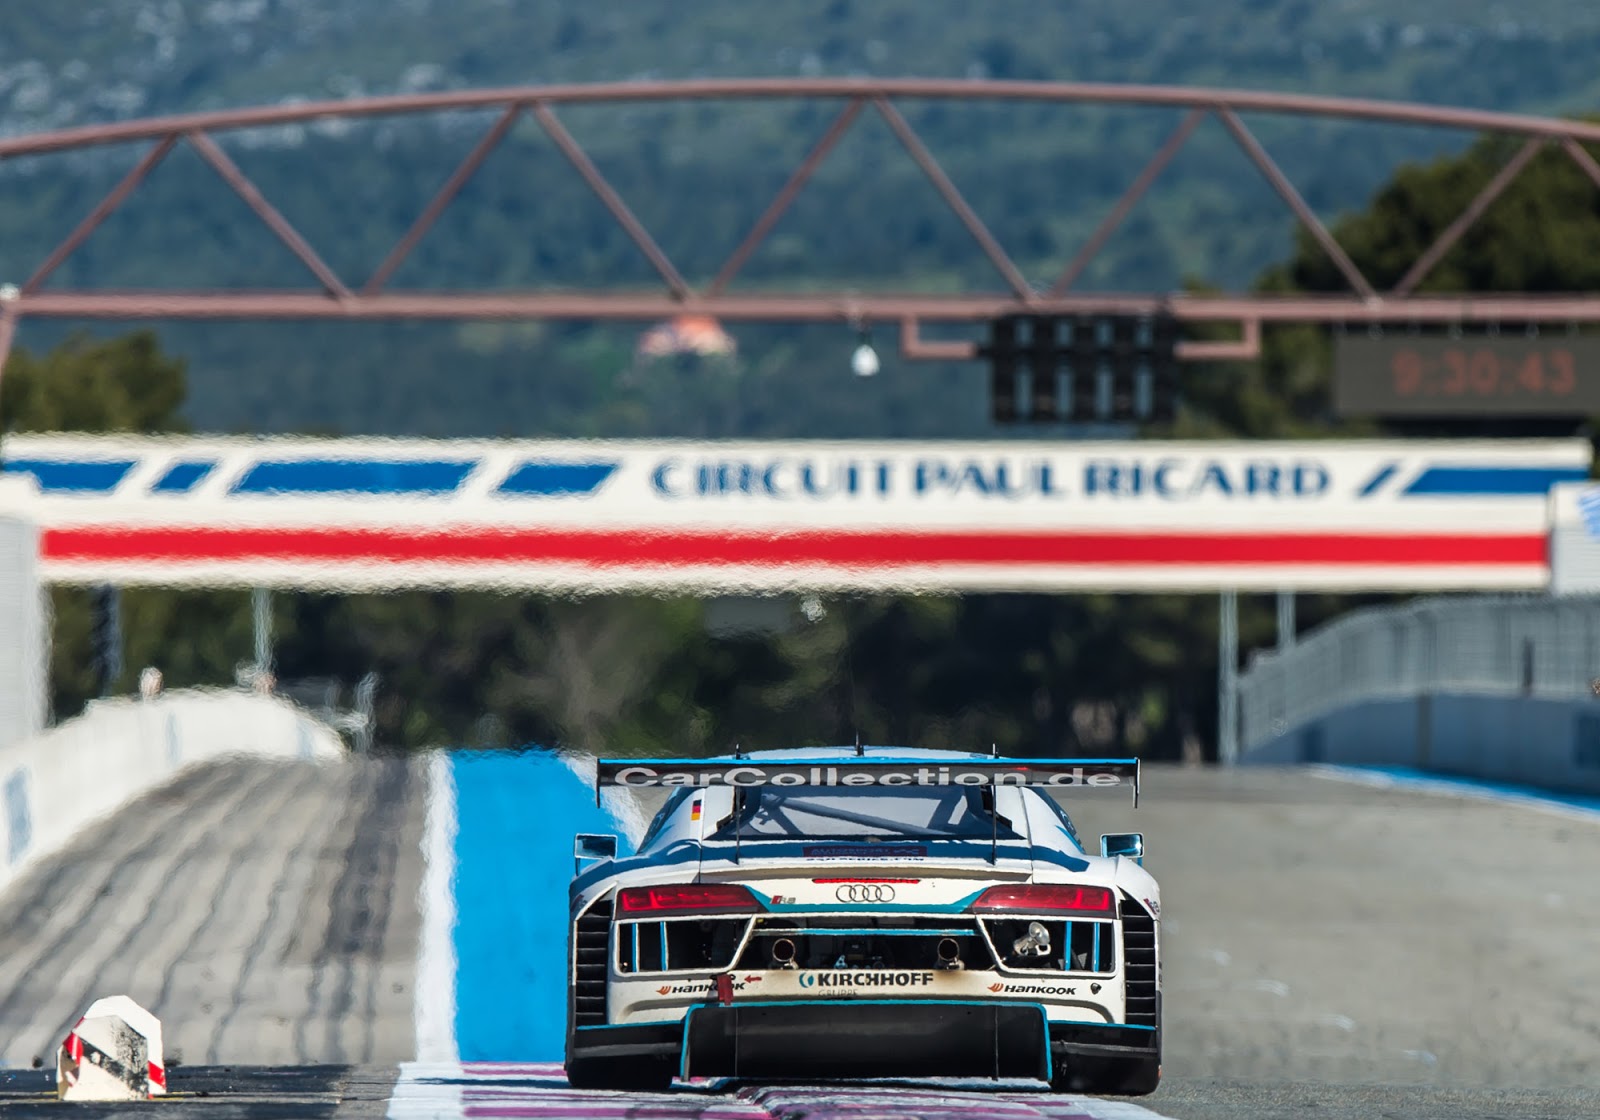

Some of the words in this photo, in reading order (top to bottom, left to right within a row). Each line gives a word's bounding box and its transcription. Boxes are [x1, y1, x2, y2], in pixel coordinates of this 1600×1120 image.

[1391, 350, 1576, 396] 9:30:43
[650, 458, 892, 498] CIRCUIT
[913, 458, 1065, 499] PAUL
[1083, 458, 1331, 499] RICARD
[614, 766, 1121, 787] CarCollection.de
[817, 972, 934, 987] KIRCHHOFF
